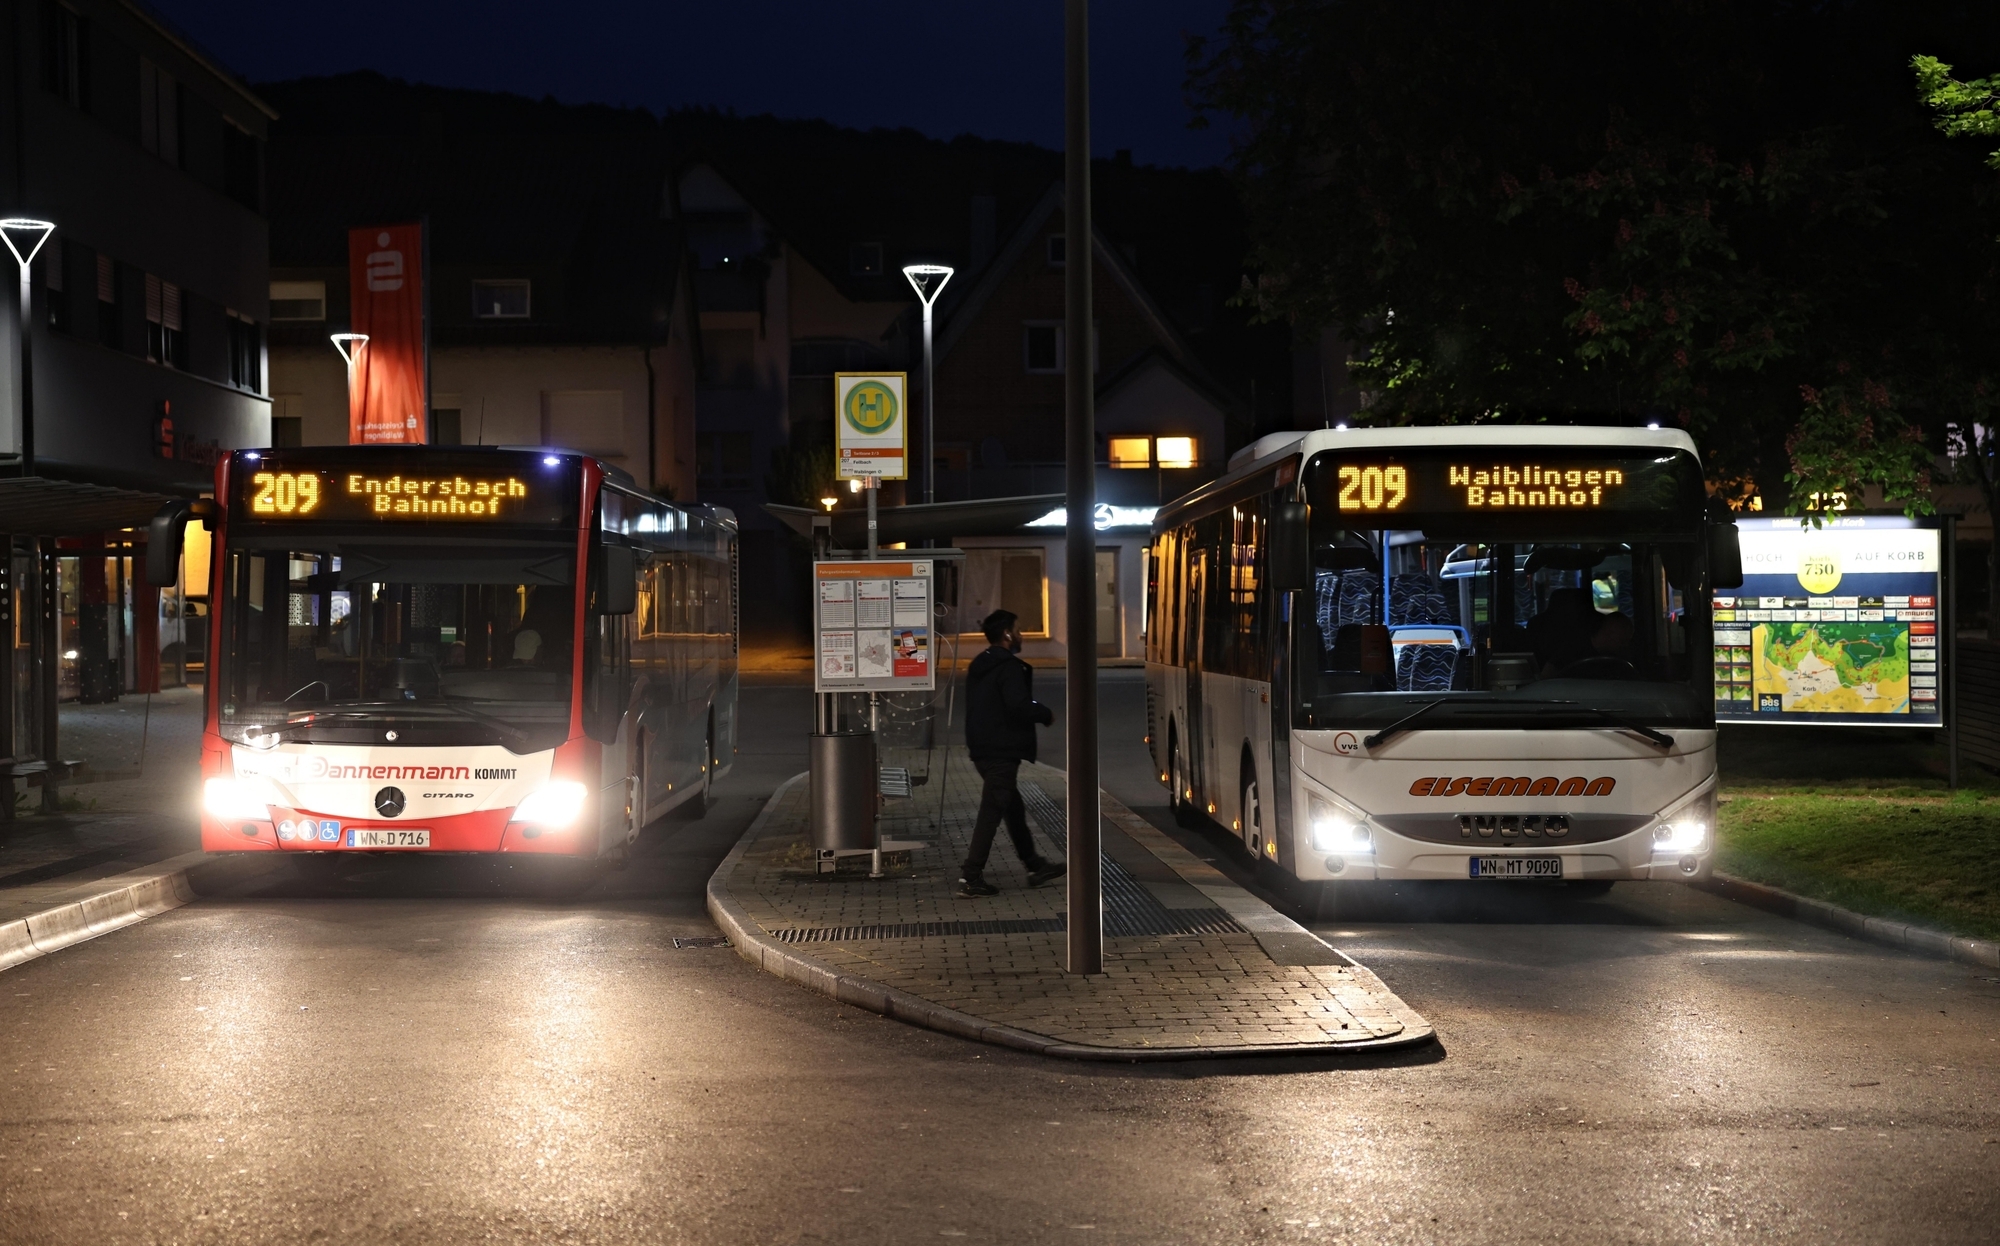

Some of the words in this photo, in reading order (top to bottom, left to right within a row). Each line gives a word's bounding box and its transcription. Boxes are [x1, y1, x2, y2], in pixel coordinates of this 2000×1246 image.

[859, 393, 883, 421] H
[254, 473, 318, 513] 209
[349, 475, 525, 496] Endersbach
[1339, 466, 1406, 509] 209
[1450, 466, 1622, 487] Waiblingen
[1468, 486, 1602, 506] Bahnhof
[375, 494, 499, 514] Bahnhof
[1746, 553, 1783, 562] HOCH
[1855, 552, 1881, 561] AUF
[1887, 551, 1925, 561] KORB
[1804, 563, 1835, 576] 750
[474, 768, 517, 780] KOMMT
[1408, 776, 1617, 797] EISEMANN
[1460, 815, 1570, 838] IVECO
[361, 832, 378, 846] WN
[387, 832, 395, 846] D
[399, 832, 424, 846] 716
[1480, 859, 1497, 874] WN
[1506, 859, 1523, 874] MT
[1526, 859, 1559, 874] 9090
